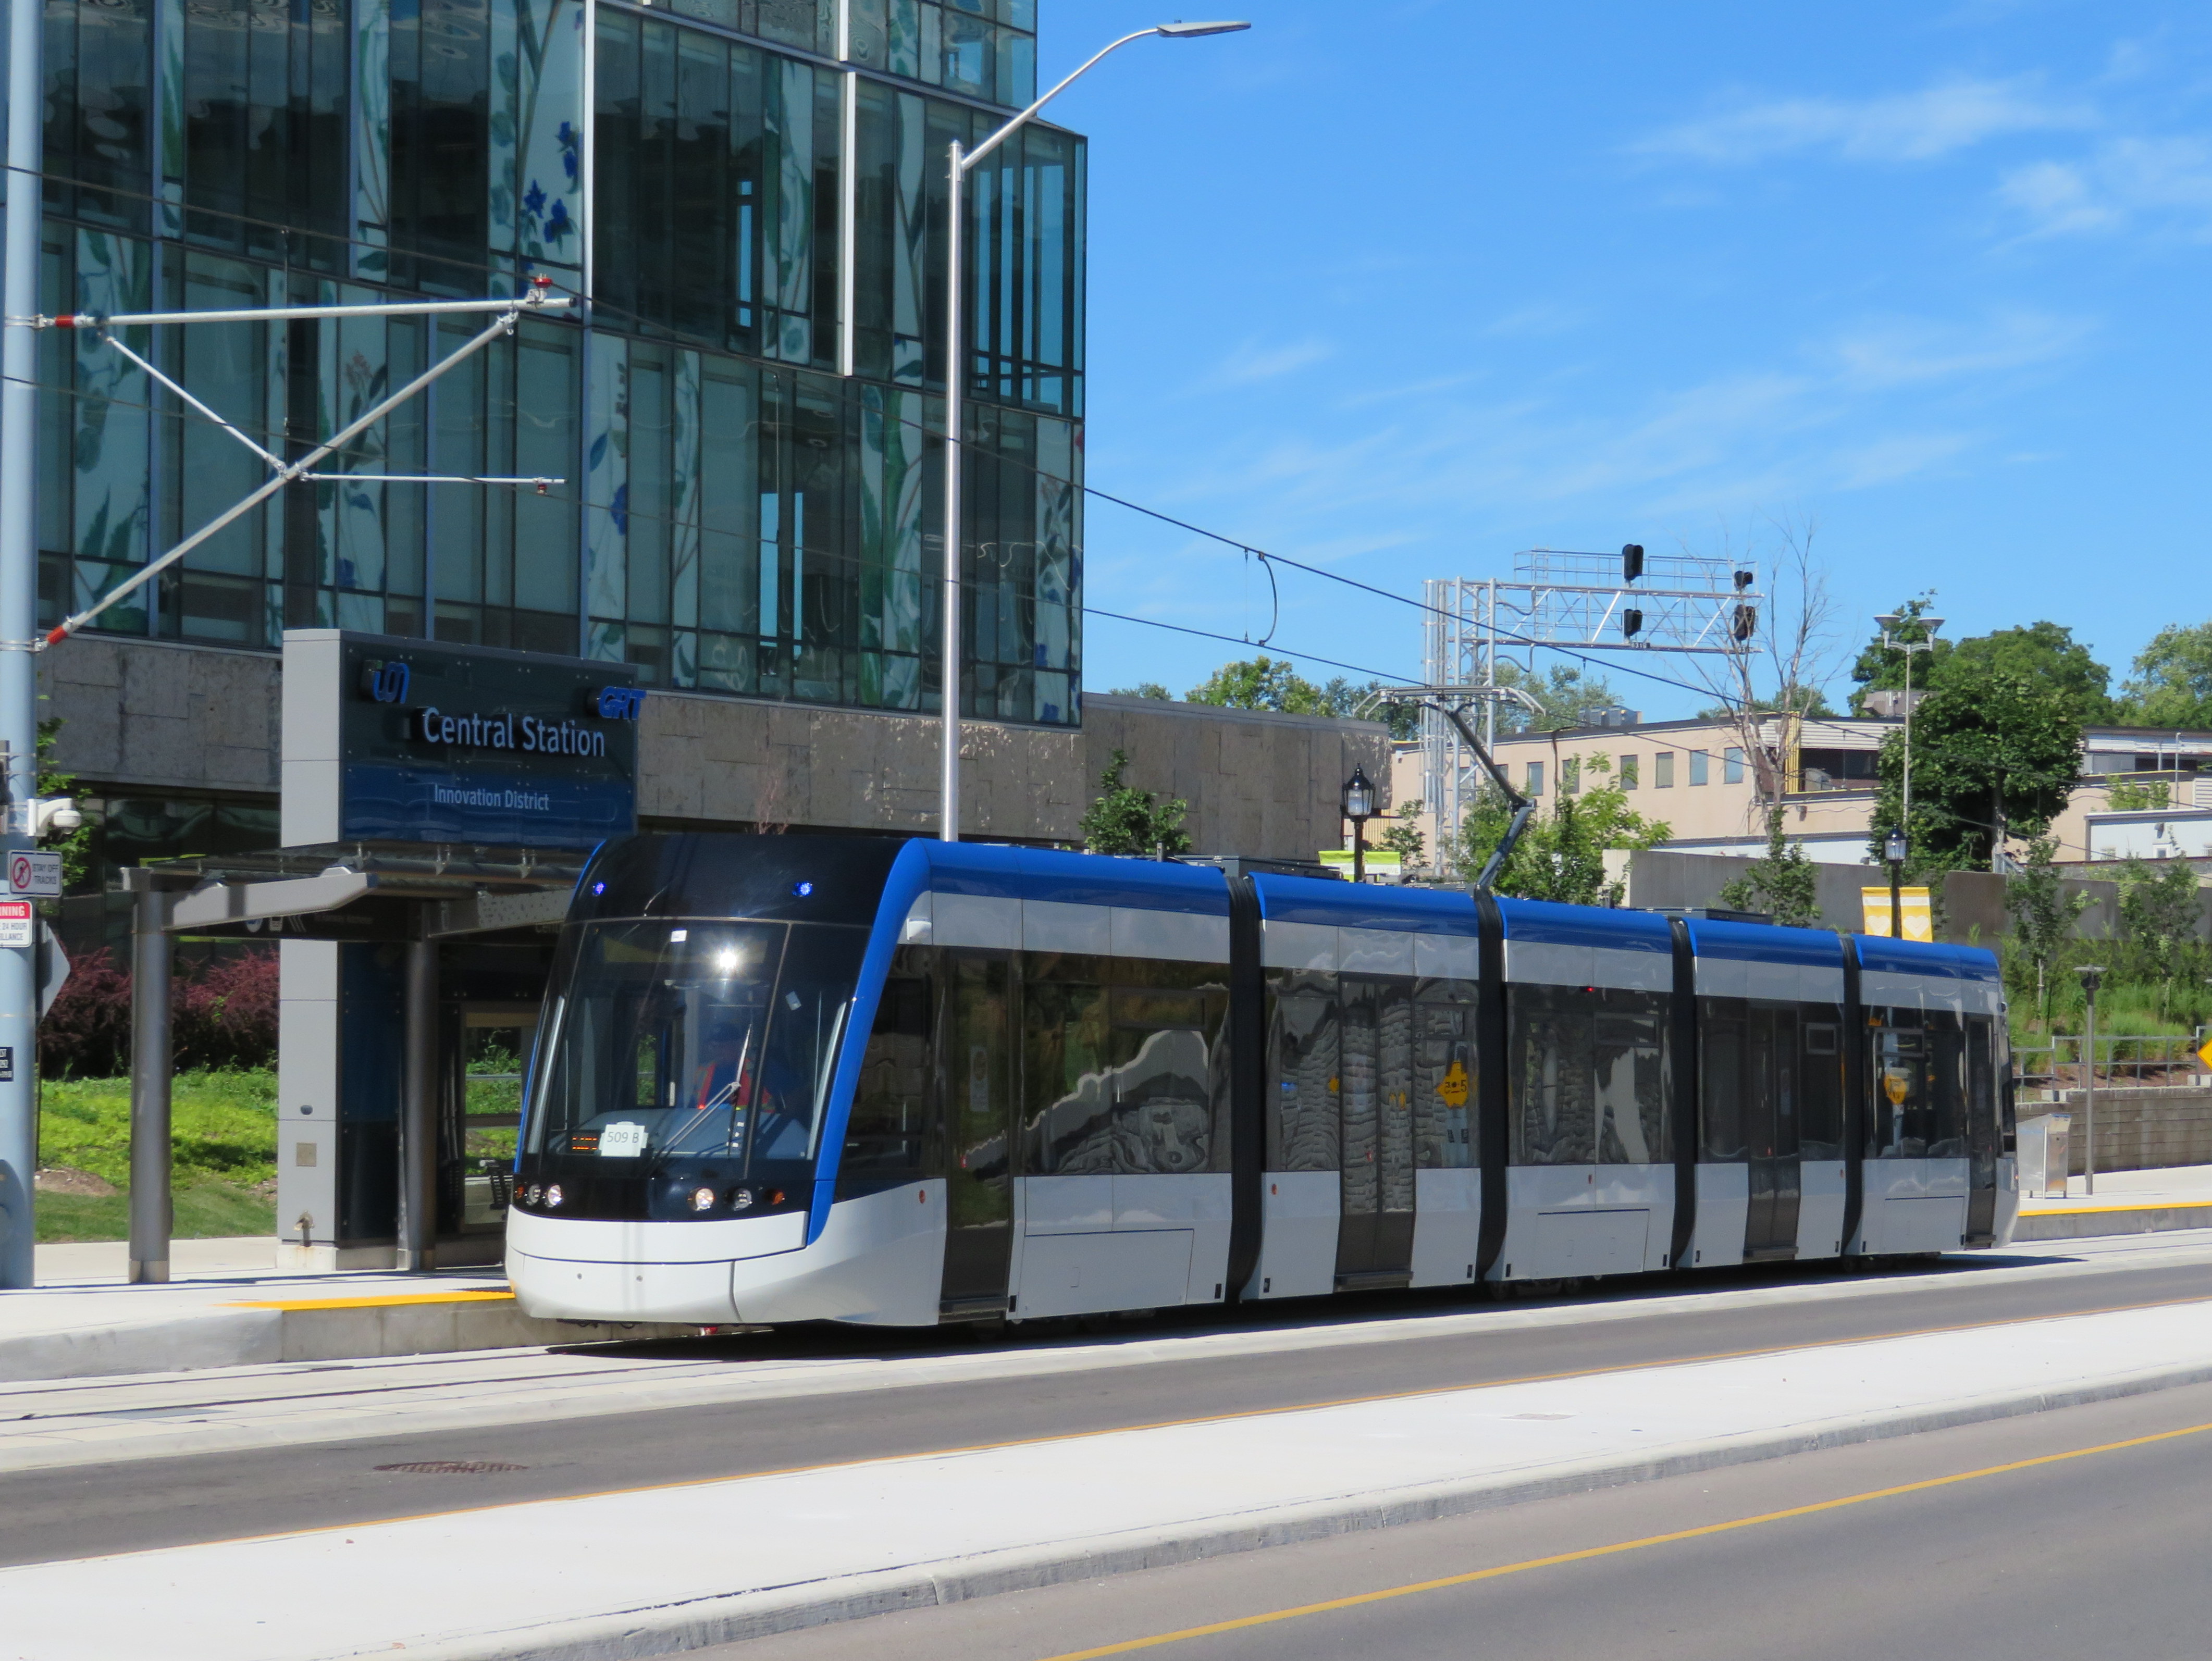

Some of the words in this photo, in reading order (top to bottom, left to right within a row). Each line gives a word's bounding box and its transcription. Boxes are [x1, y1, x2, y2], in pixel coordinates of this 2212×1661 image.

[598, 686, 647, 720] GRT
[424, 706, 515, 749] Central
[523, 716, 605, 757] Station
[435, 784, 501, 808] Innovation
[505, 789, 550, 811] District
[34, 876, 57, 885] TRACKS
[607, 1131, 628, 1143] 509
[632, 1132, 639, 1143] B
